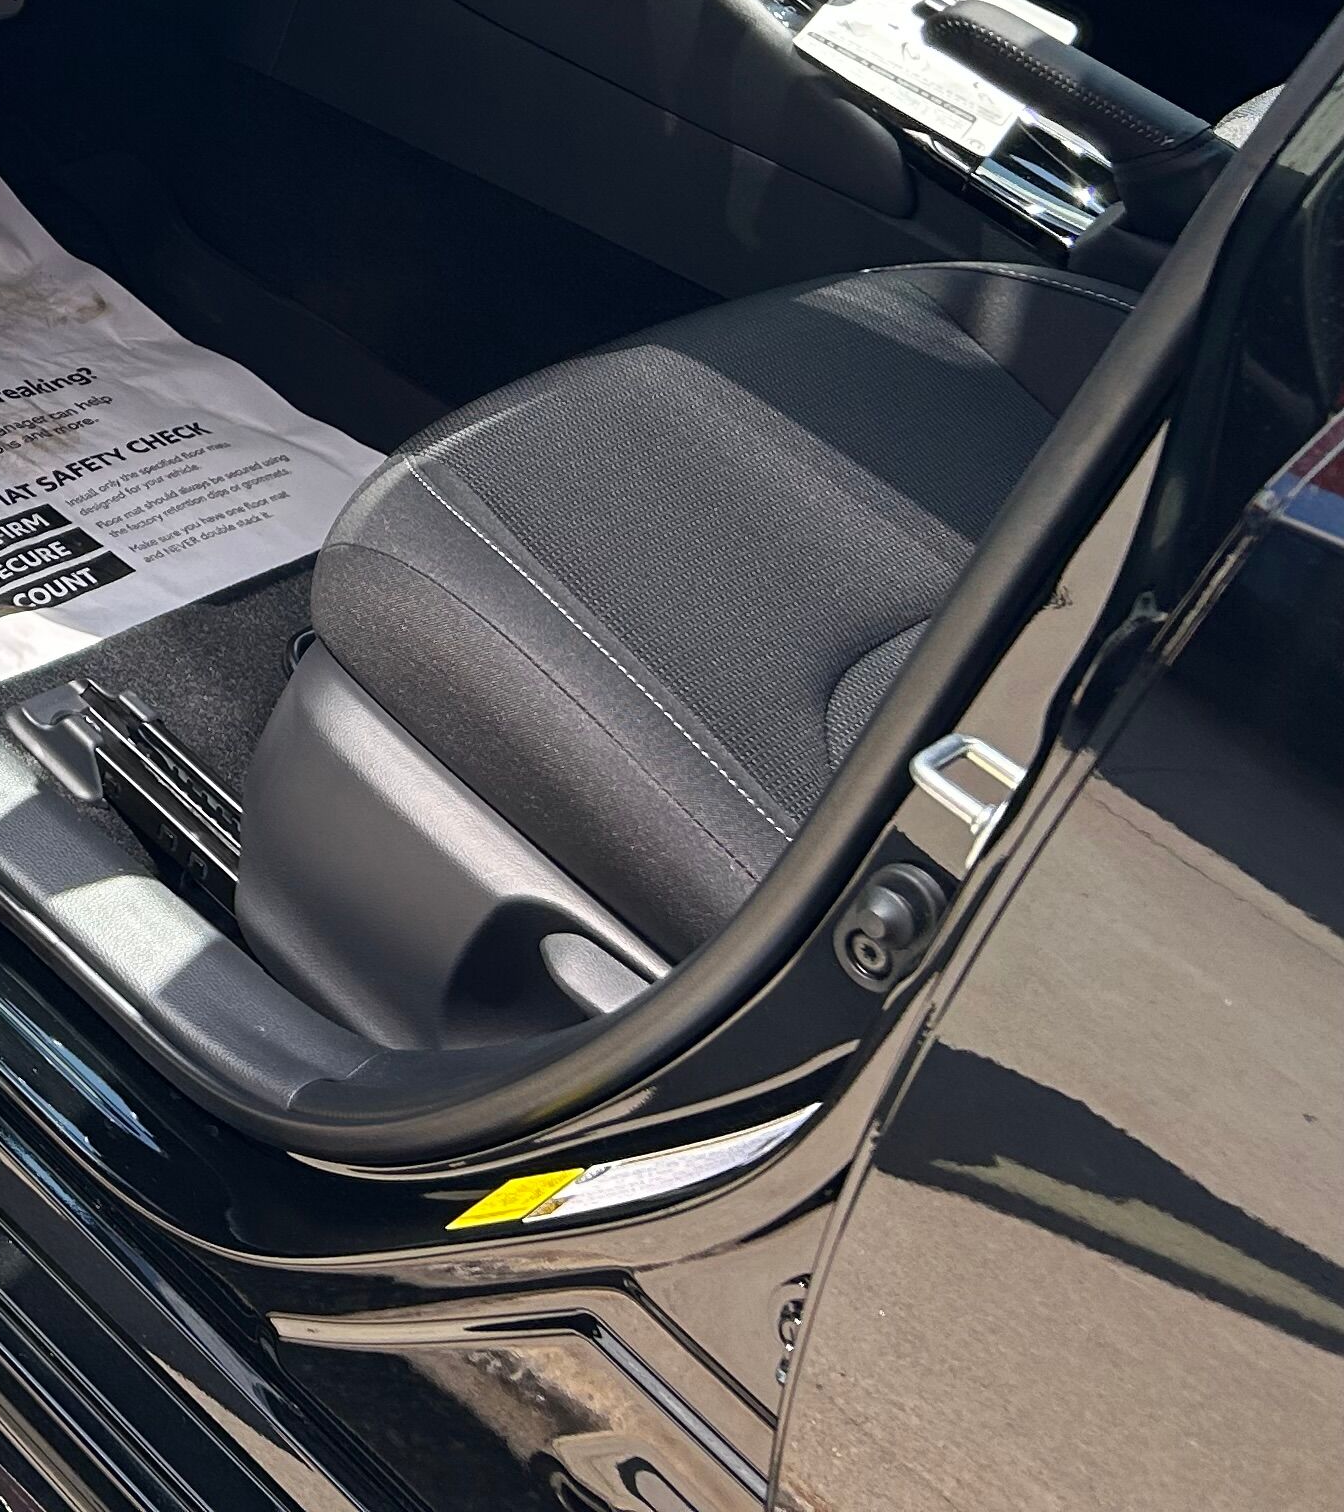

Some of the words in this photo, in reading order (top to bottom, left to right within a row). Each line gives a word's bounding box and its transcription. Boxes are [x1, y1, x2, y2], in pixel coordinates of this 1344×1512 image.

[49, 407, 79, 420] can
[74, 395, 113, 411] help
[22, 428, 52, 444] and
[53, 418, 100, 435] more.
[36, 447, 127, 492] SAFETY
[126, 421, 214, 453] CHECK
[65, 488, 99, 507] Install
[98, 478, 121, 492] only
[119, 471, 139, 481] the
[138, 455, 183, 474] specified
[180, 448, 206, 459] floor
[80, 490, 127, 516] designed
[124, 485, 141, 495] for
[142, 475, 165, 490] your
[95, 515, 124, 528] Floor
[123, 506, 146, 519] mat
[144, 489, 179, 509] should
[208, 475, 225, 485] be
[224, 461, 263, 479] secured
[262, 454, 290, 467] using
[109, 527, 128, 538] the
[125, 514, 164, 531] factory
[163, 495, 207, 517] retention
[128, 538, 158, 552] Make
[157, 530, 182, 543] sure
[180, 522, 201, 535] you
[198, 513, 226, 524] have
[225, 506, 246, 517] one
[243, 499, 269, 510] floor
[144, 550, 165, 563] and
[163, 536, 201, 555] NEVER
[200, 524, 236, 540] double
[12, 567, 99, 608] COUNT
